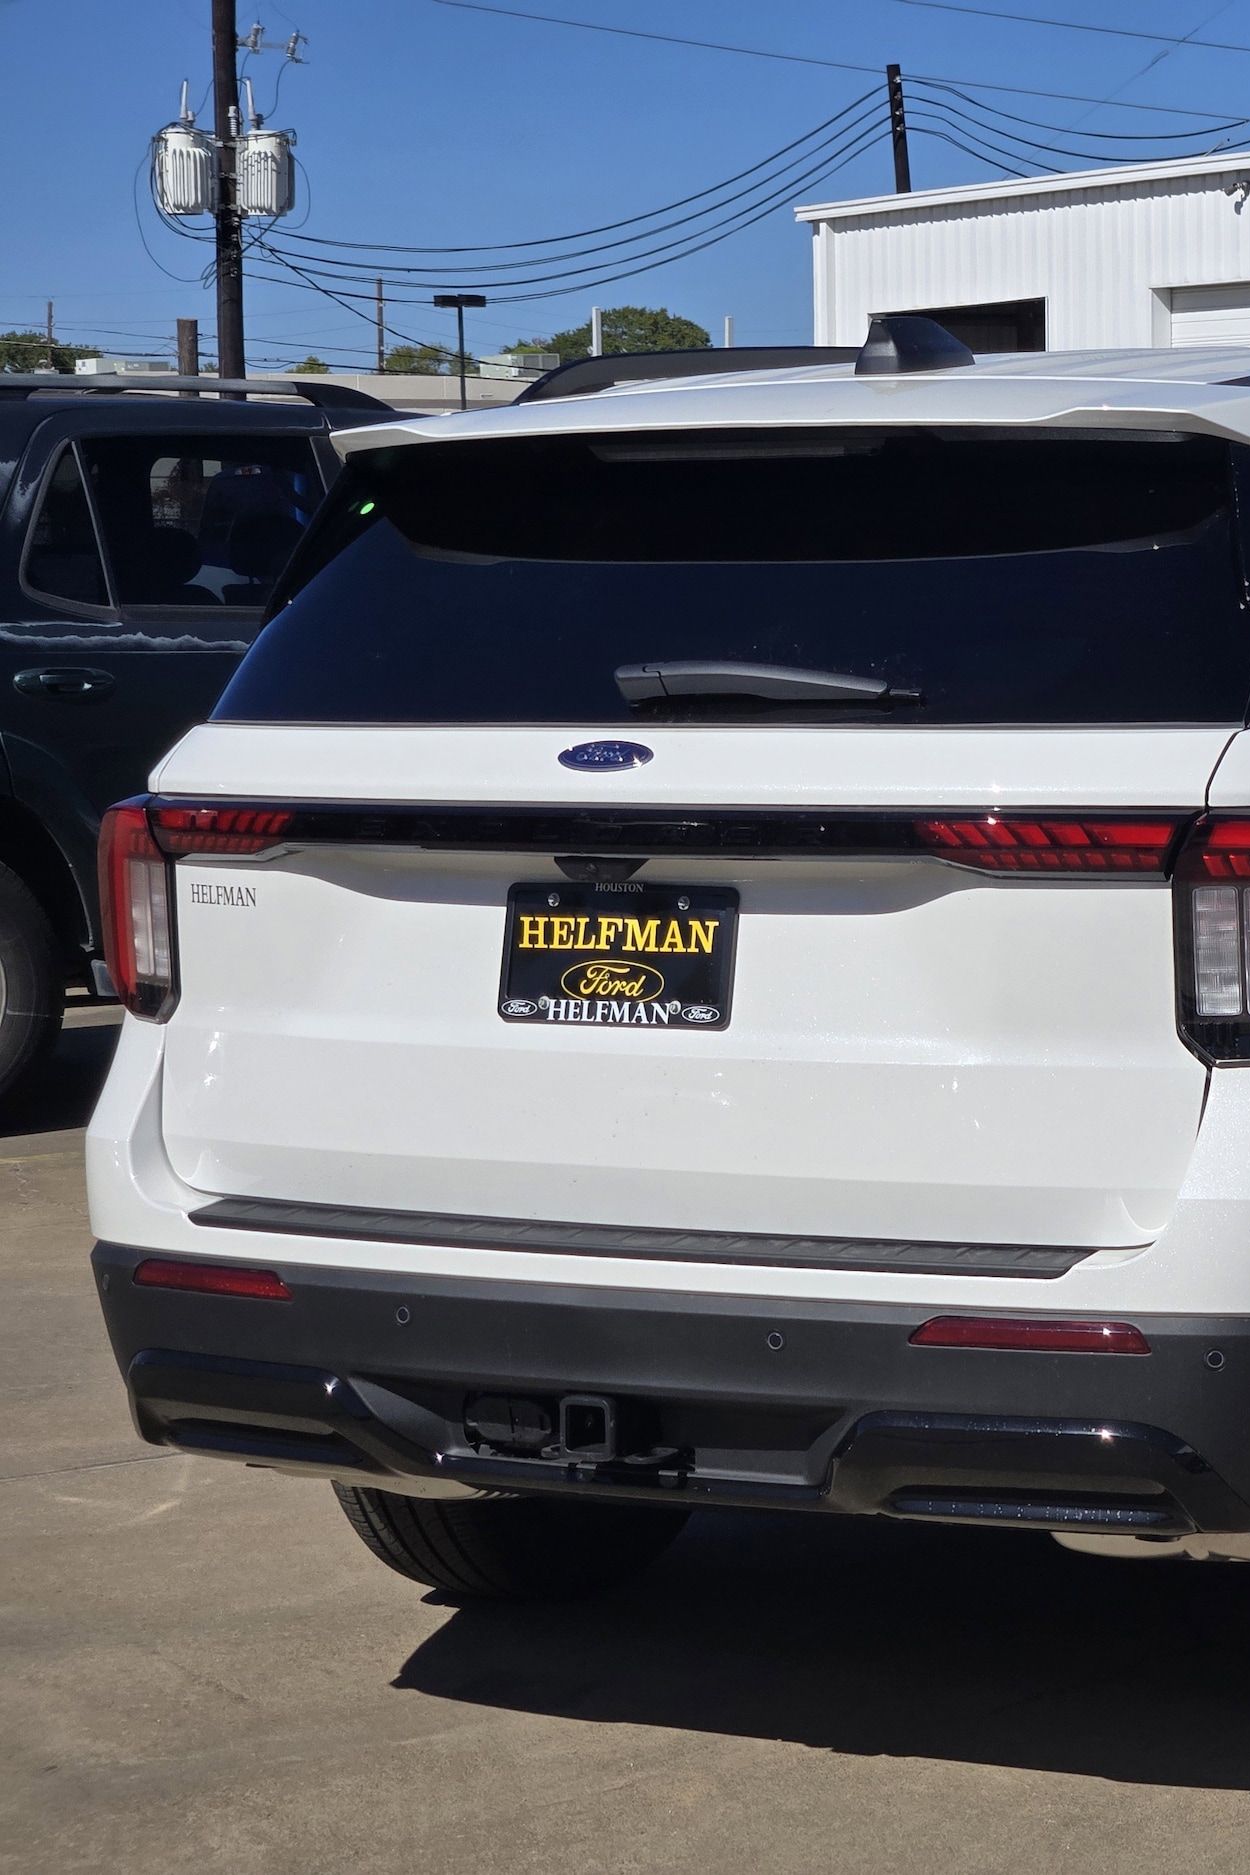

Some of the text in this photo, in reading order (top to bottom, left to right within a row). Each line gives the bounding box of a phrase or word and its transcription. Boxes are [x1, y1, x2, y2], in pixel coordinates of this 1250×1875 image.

[190, 883, 257, 907] HELFMAN
[595, 882, 645, 893] HOUSTON
[518, 915, 720, 954] HELFMAN
[579, 964, 647, 997] Ford
[545, 999, 671, 1025] HELFMAN
